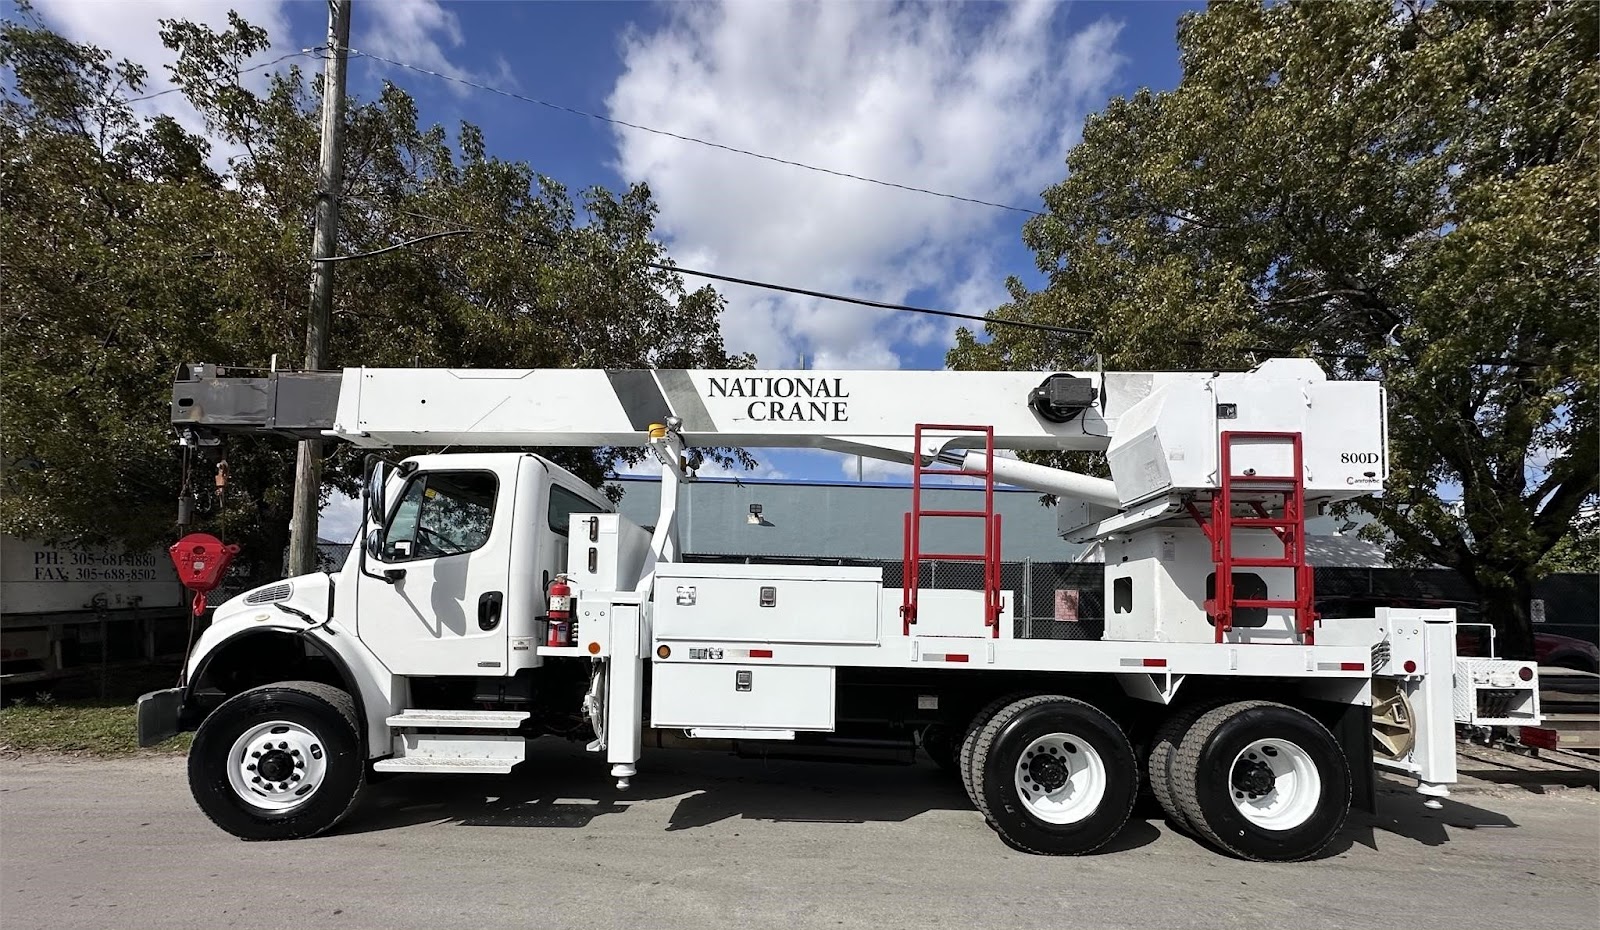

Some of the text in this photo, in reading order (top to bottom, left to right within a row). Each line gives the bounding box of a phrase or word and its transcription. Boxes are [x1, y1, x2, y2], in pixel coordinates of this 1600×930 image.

[708, 377, 850, 398] NATIONAL
[747, 401, 849, 421] CRANE
[1340, 452, 1379, 464] 800D
[34, 551, 63, 565] PH:
[34, 567, 157, 581] FAX: 305-688-8502
